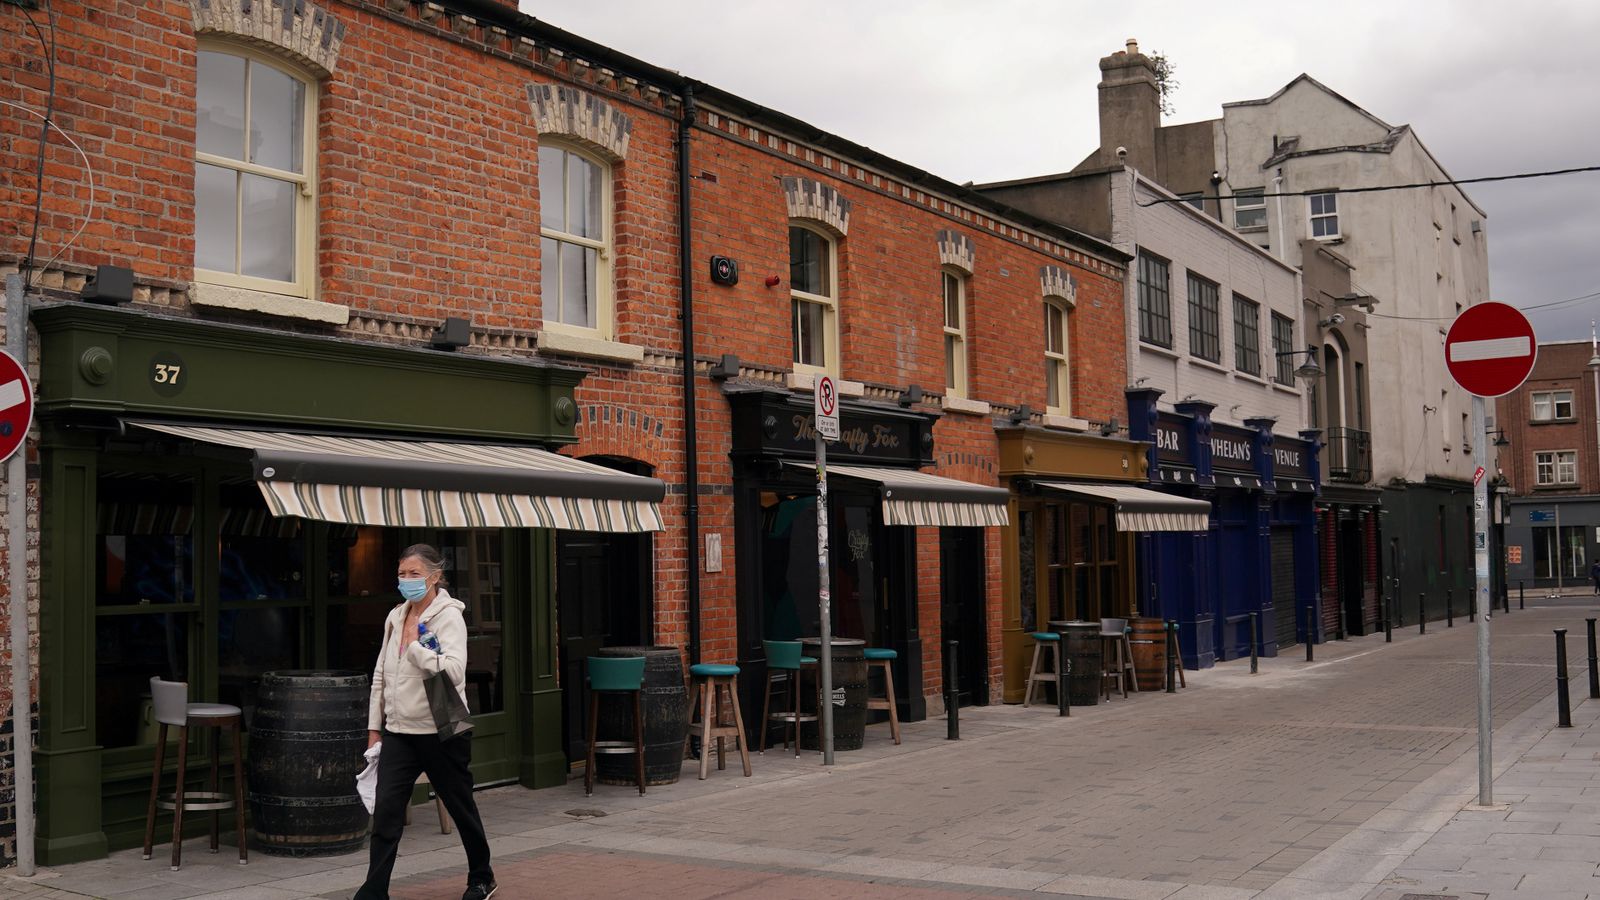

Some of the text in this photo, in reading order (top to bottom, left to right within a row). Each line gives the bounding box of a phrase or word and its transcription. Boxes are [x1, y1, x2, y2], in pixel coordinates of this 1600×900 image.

[154, 363, 181, 385] 37
[872, 424, 900, 448] Fox
[1156, 428, 1179, 451] BAR
[1274, 448, 1300, 468] VENUE
